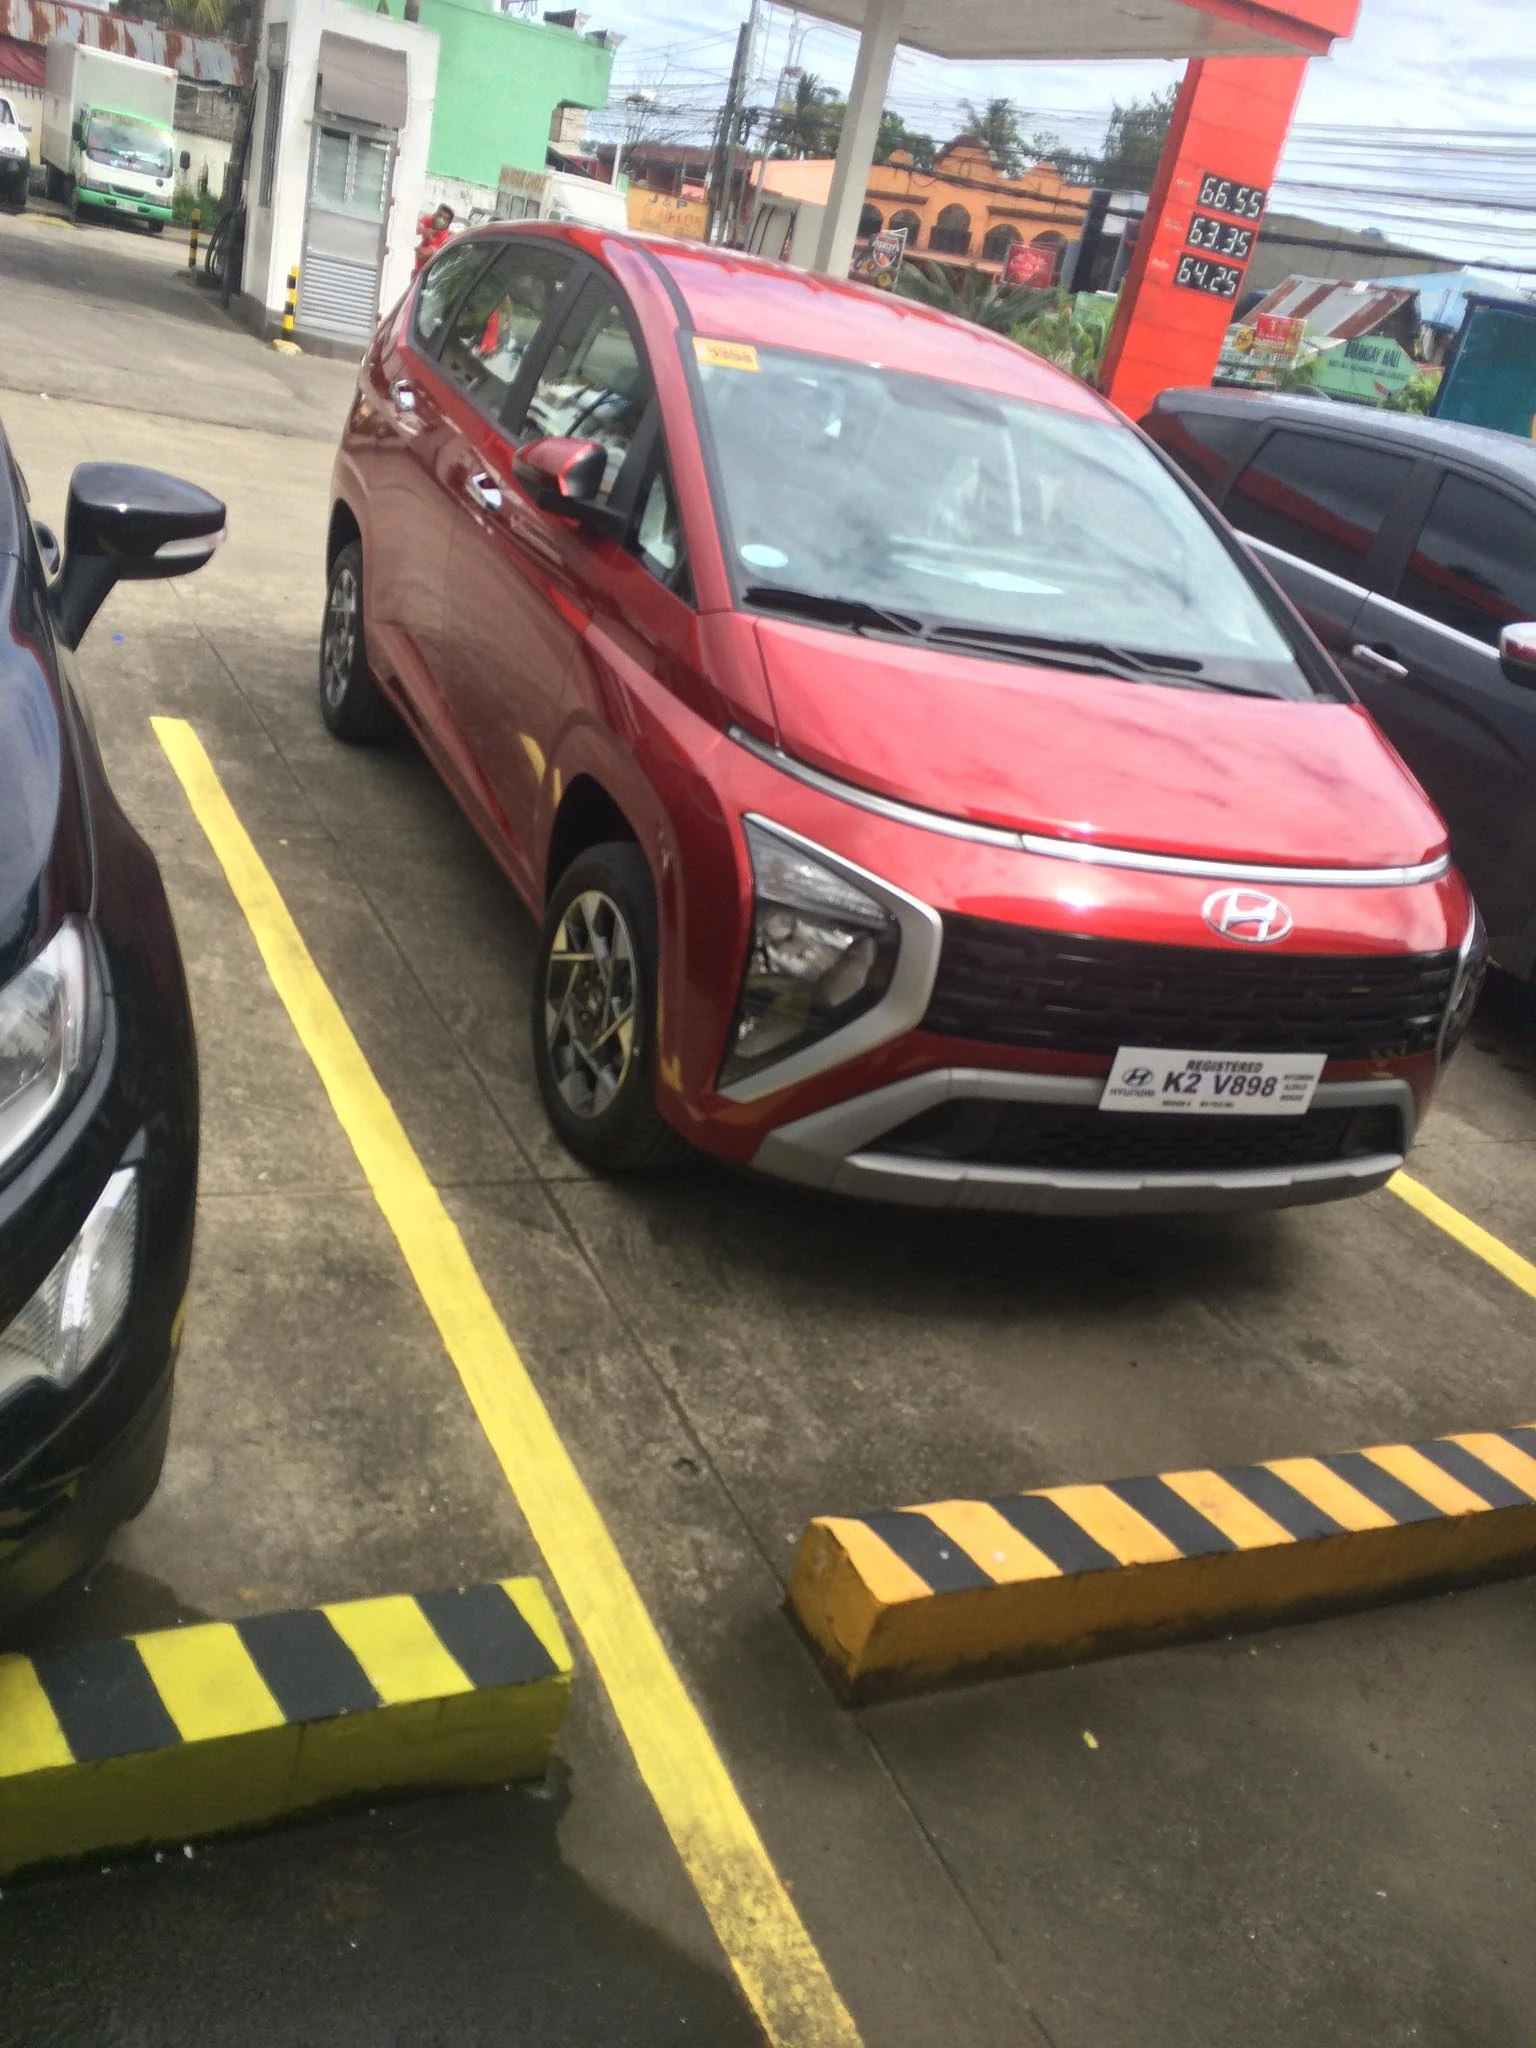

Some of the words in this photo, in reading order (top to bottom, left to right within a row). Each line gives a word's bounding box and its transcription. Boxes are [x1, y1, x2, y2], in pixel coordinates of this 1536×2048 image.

[1200, 177, 1263, 218] 66.55
[1189, 217, 1252, 257] 63.35
[1177, 257, 1239, 295] 64.25
[1162, 1071, 1202, 1094] K2
[1213, 1073, 1278, 1097] V898
[1185, 1059, 1264, 1073] REGISTERED
